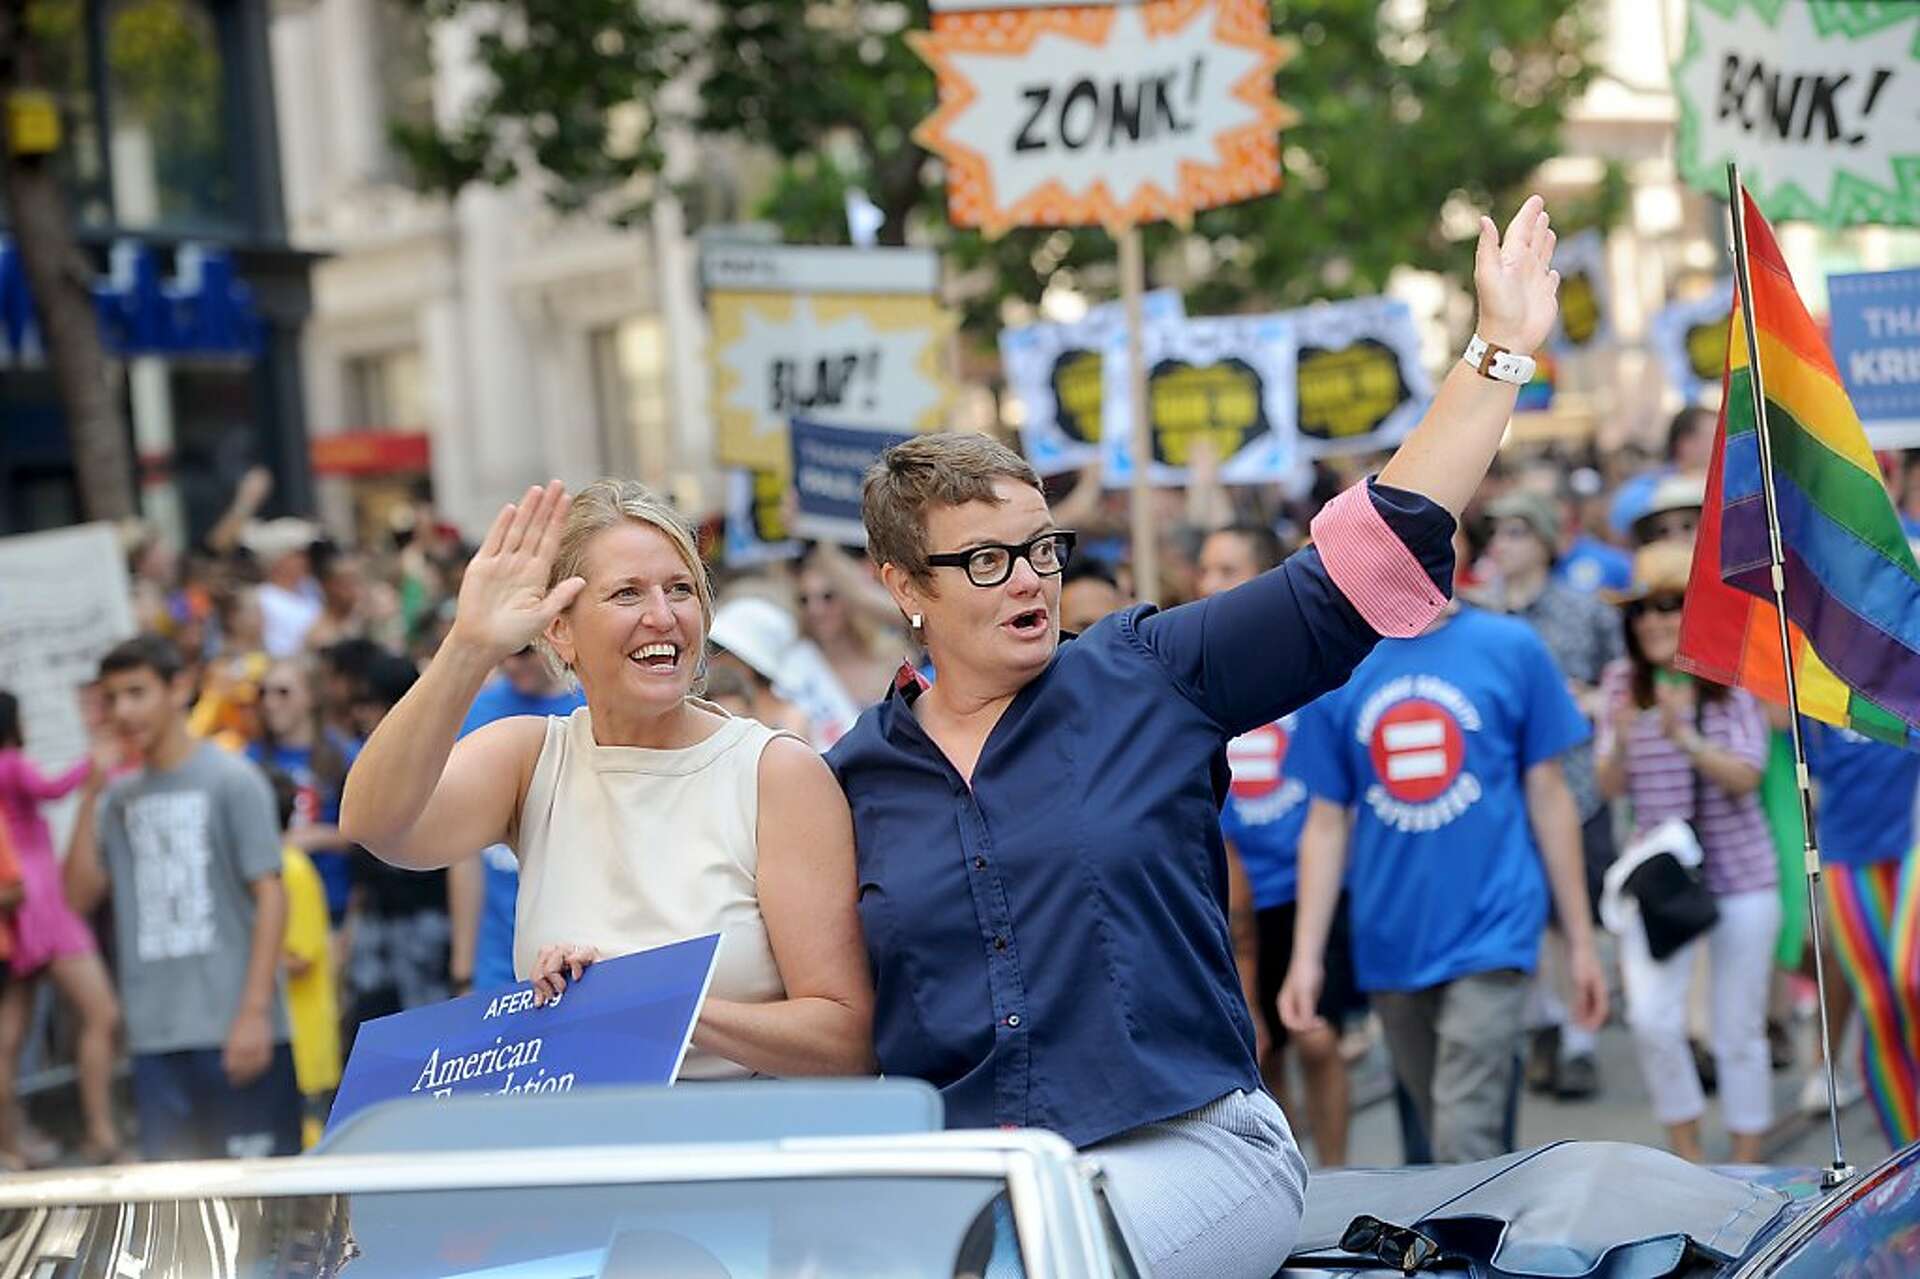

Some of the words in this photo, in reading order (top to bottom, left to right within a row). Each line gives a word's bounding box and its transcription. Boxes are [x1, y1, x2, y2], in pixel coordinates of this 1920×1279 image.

[1014, 55, 1204, 152] ZONK!
[1718, 52, 1893, 146] BONK!
[482, 988, 564, 1021] AFER.g
[411, 1036, 542, 1092] American
